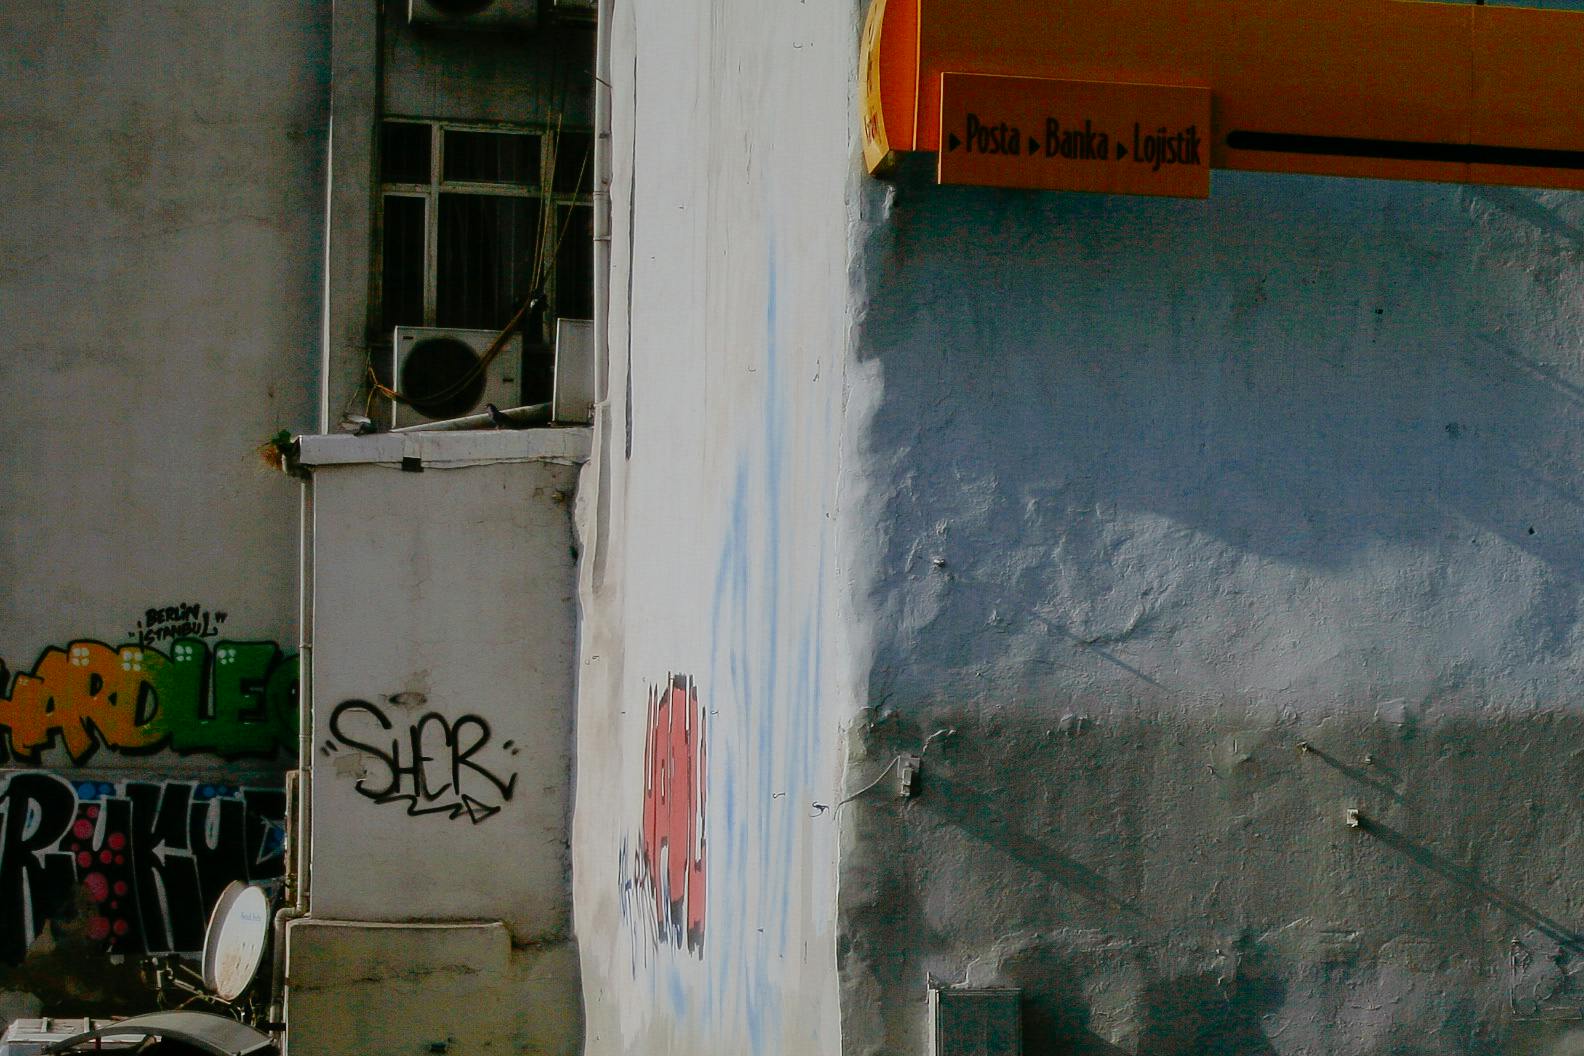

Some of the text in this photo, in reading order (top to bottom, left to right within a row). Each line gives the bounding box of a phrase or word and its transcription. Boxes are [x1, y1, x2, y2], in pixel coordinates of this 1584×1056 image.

[966, 112, 1201, 172] Posta Banka Lojistik
